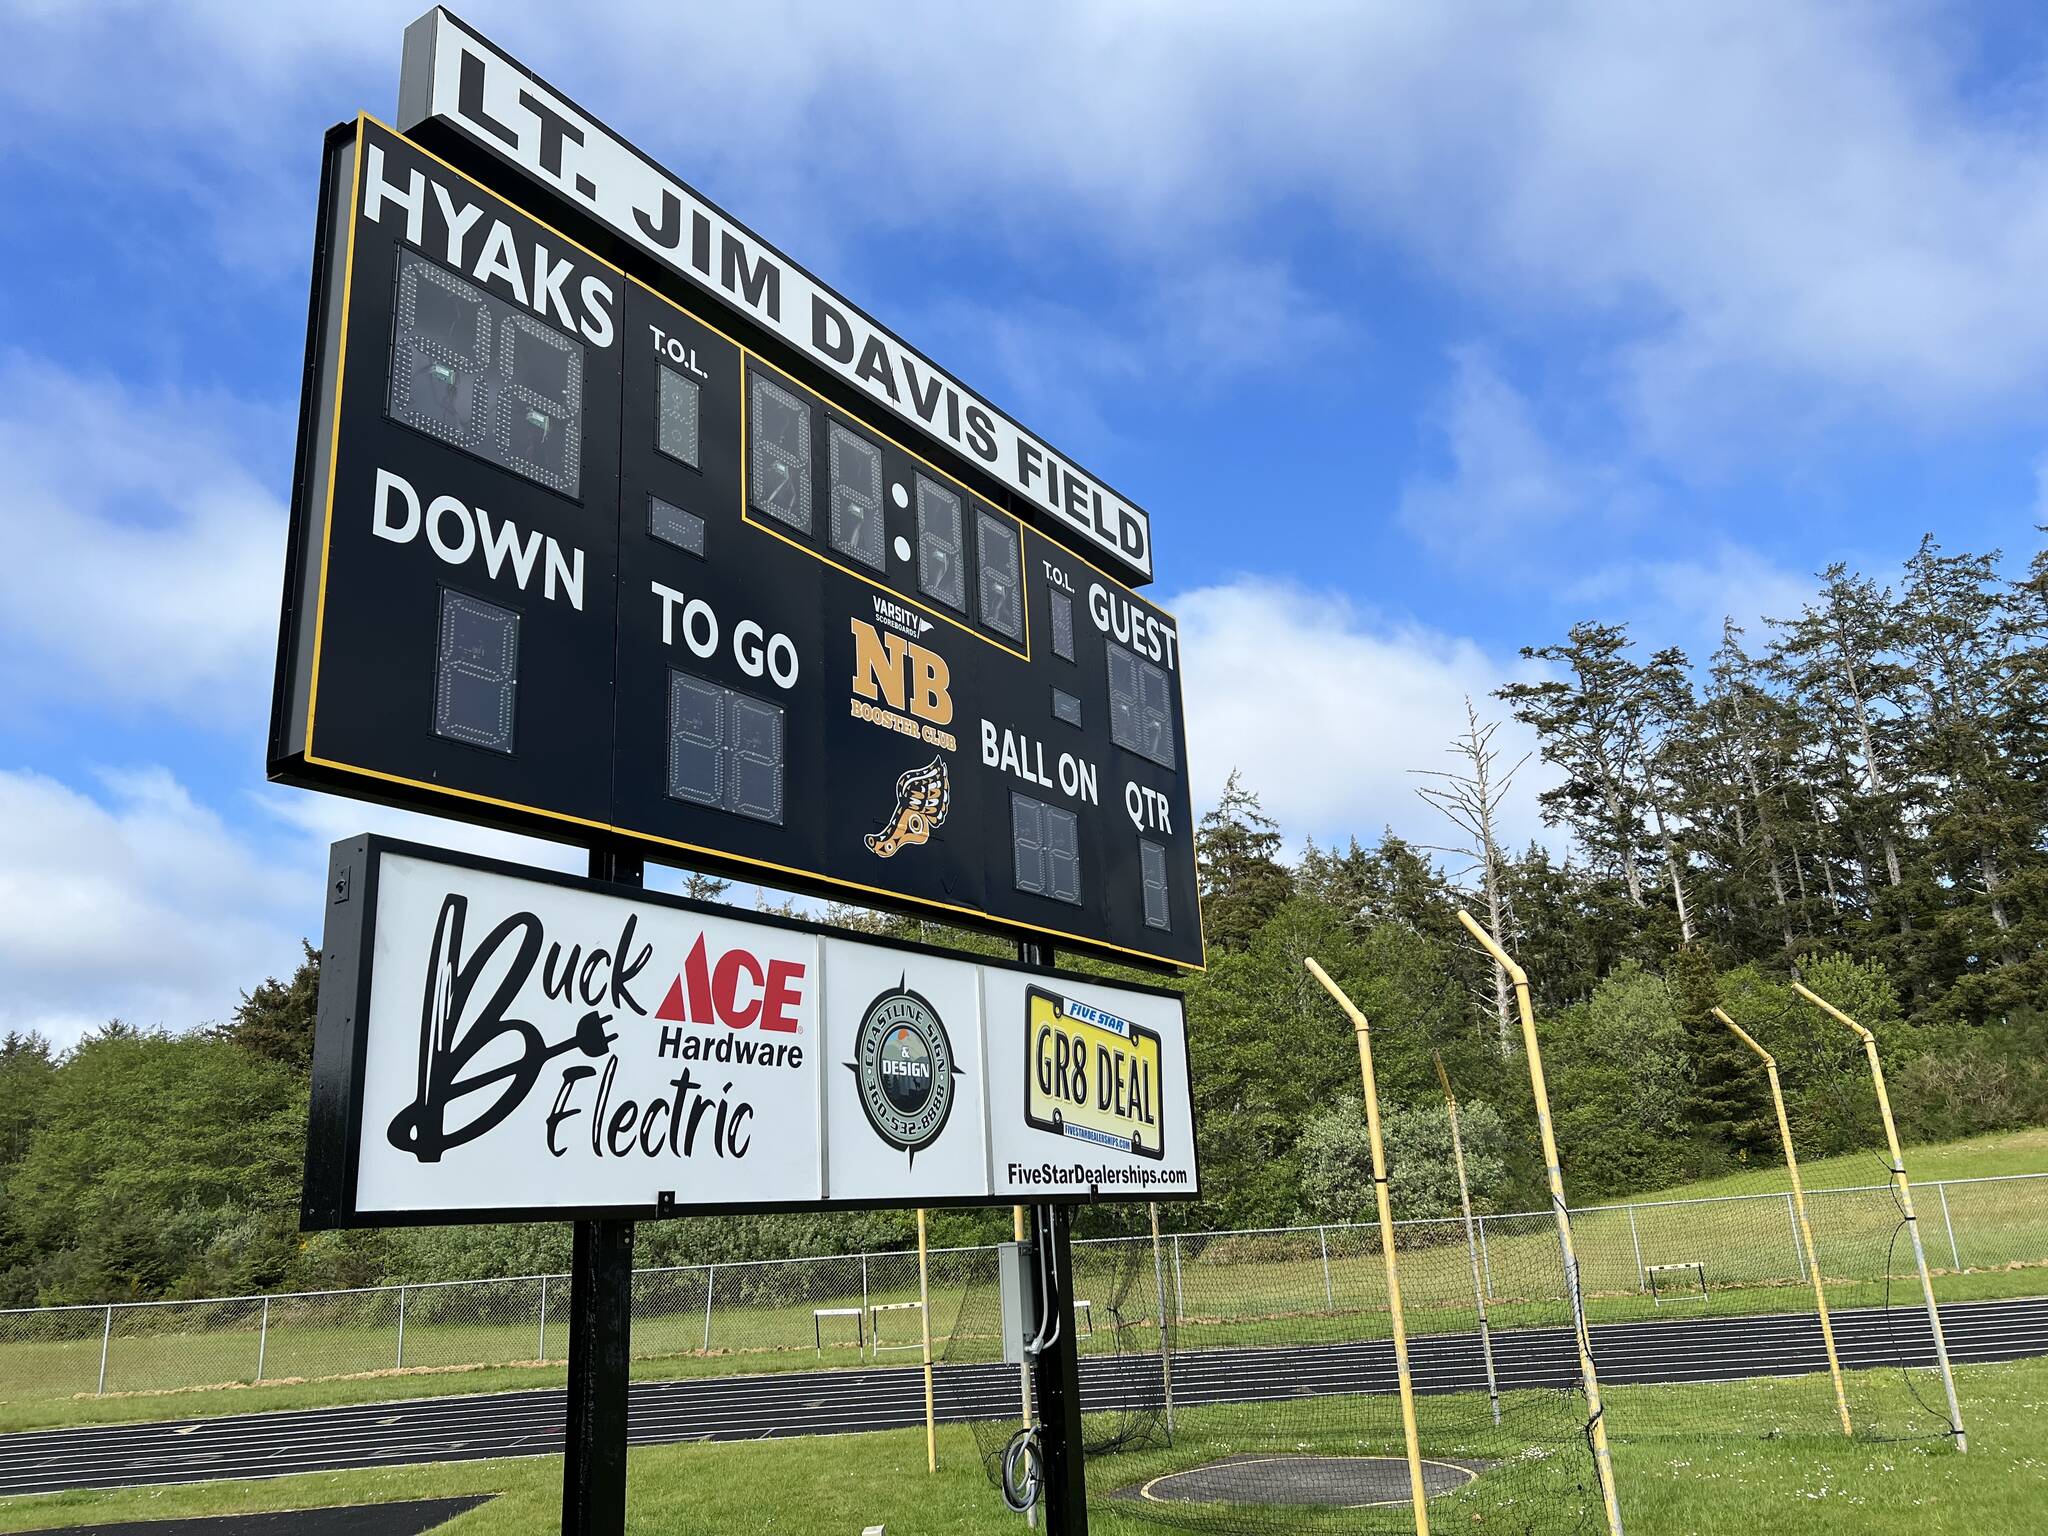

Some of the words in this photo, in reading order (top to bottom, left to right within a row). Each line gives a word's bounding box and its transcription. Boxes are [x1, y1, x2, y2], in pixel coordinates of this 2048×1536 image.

[364, 143, 614, 348] HYAKS
[458, 48, 596, 202] LT.
[632, 188, 780, 324] JIM
[811, 292, 998, 463] DAVIS
[1017, 438, 1145, 560] FIELD
[649, 324, 709, 379] T.O.L.
[373, 468, 584, 611] DOWN
[1043, 560, 1075, 594] T.O.L.
[652, 581, 719, 658] TO
[733, 620, 799, 689] GO
[873, 595, 919, 629] VARSITY
[875, 613, 917, 638] SCOREBOARDS
[1088, 583, 1176, 670] GUEST
[851, 617, 954, 725] NB
[851, 698, 921, 739] BOOSTER
[921, 725, 957, 751] CLUB
[981, 719, 1053, 789] BALL
[1058, 752, 1098, 806] ON
[1125, 781, 1173, 835] QTR
[654, 930, 806, 1034] ACE
[387, 893, 653, 1163] Buck
[866, 1004, 924, 1067] COASTLINE
[926, 1023, 946, 1073] SIGN
[1069, 1002, 1096, 1024] FIVE
[1098, 1012, 1125, 1034] STAR
[658, 1026, 803, 1068] Hardware
[882, 1060, 930, 1078] DESIGN
[901, 1046, 911, 1059] &
[1036, 1025, 1087, 1105] GR8
[1097, 1043, 1155, 1125] DEAL
[546, 1054, 754, 1159] Electric
[867, 1078, 945, 1135] 360-532-8888
[1065, 1124, 1131, 1150] FIVESTARDEALERSHIPS.COM
[1008, 1163, 1187, 1188] FiveStarDealerships.com
